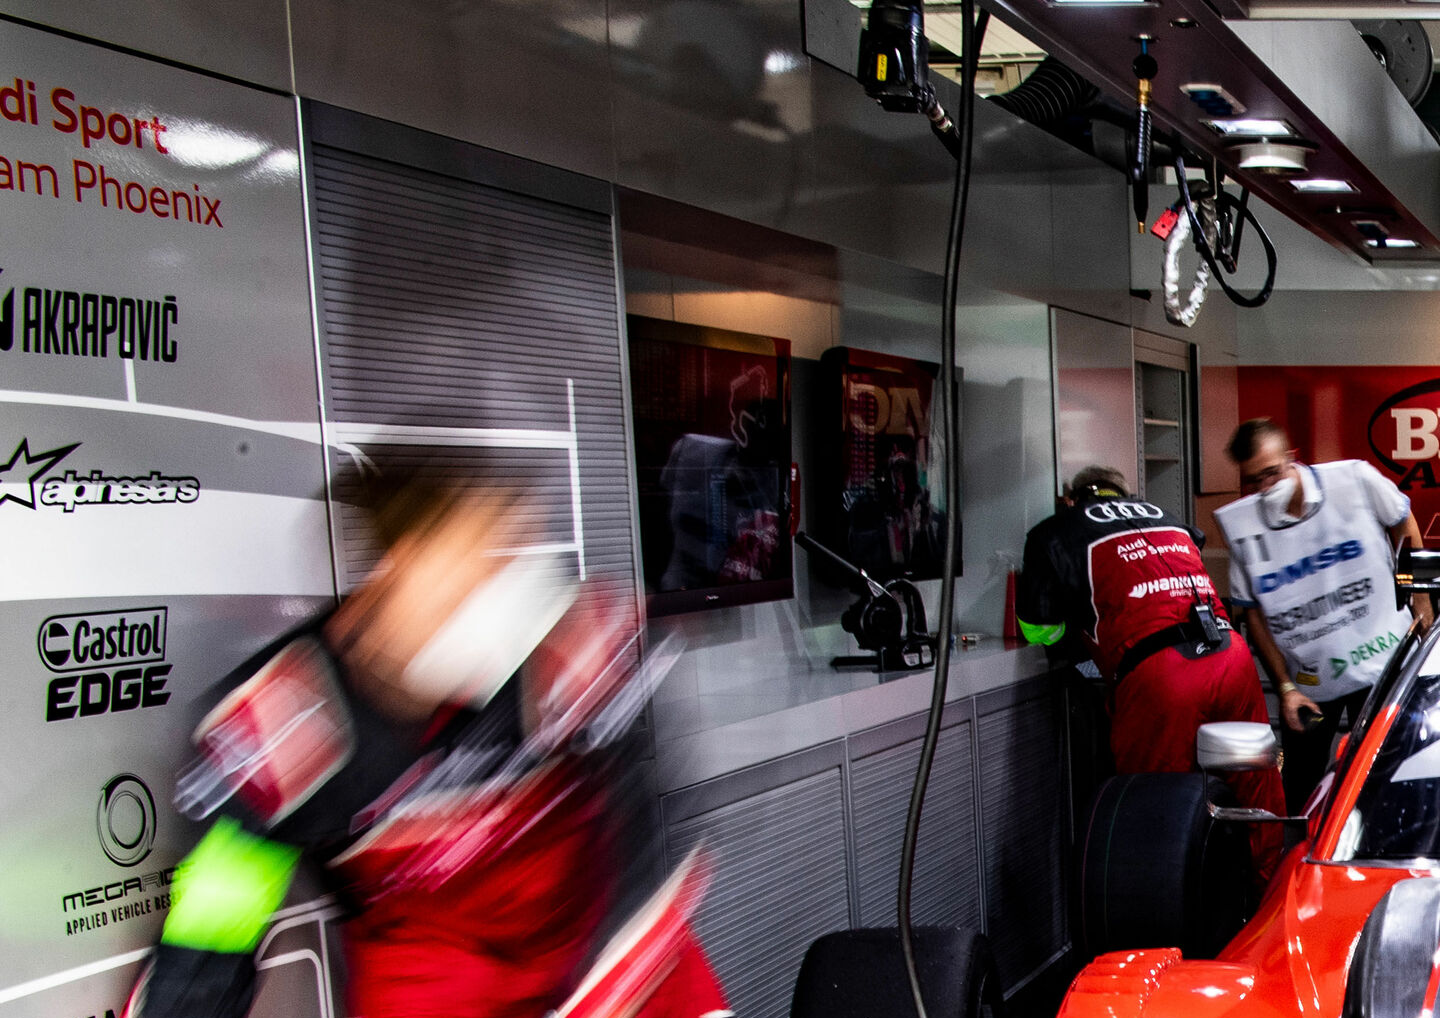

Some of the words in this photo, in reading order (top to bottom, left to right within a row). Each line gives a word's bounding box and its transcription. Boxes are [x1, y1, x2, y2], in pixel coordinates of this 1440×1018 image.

[0, 77, 38, 126] di
[51, 87, 168, 154] Sport
[0, 155, 59, 199] am
[73, 159, 223, 228] Phoenix
[41, 470, 200, 513] alpinestars
[1117, 538, 1147, 554] Audi
[1120, 549, 1147, 563] Top
[72, 614, 162, 664] Castrol
[1350, 631, 1400, 666] DEKRA
[46, 664, 173, 722] EDGE
[66, 911, 109, 936] APPLIED
[111, 899, 152, 923] VEHICLE
